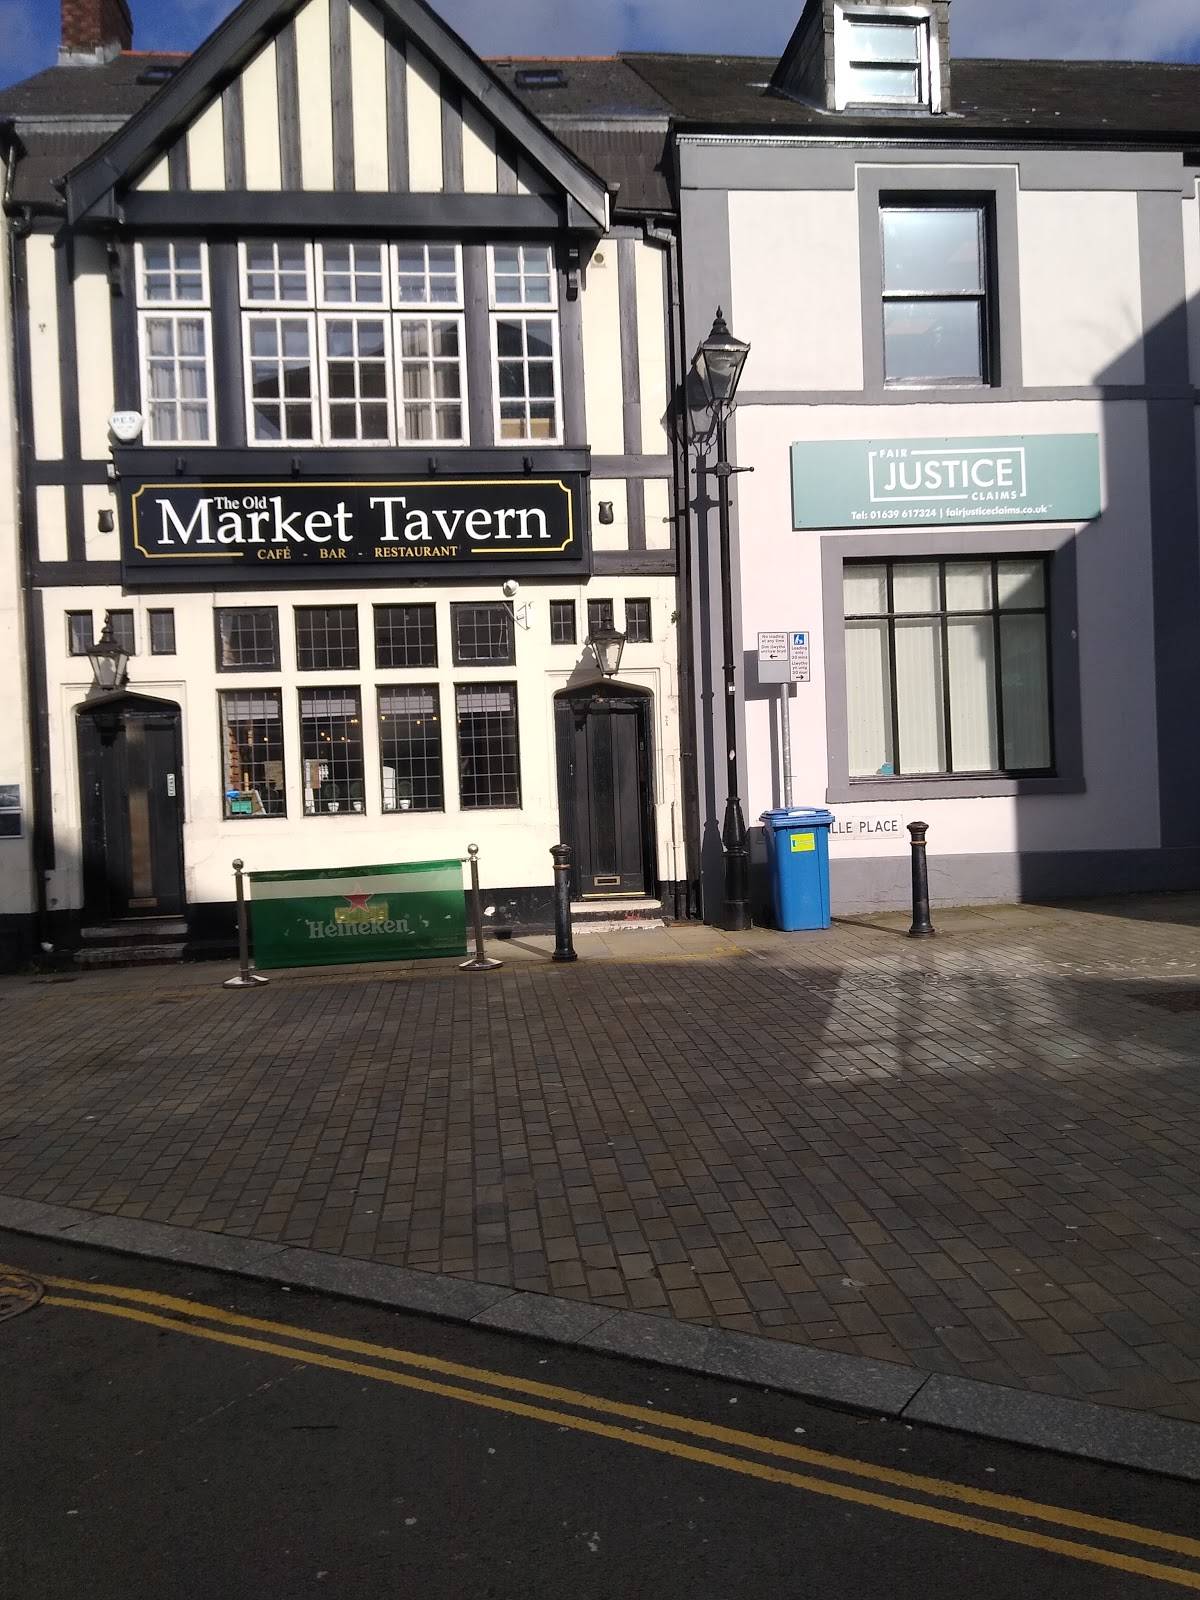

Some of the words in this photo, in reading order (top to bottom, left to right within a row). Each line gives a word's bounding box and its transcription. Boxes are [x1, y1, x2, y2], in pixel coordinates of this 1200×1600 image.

[879, 449, 909, 458] FAIR
[883, 458, 1014, 490] JUSTICE
[214, 496, 240, 510] The
[242, 495, 267, 510] Old
[971, 490, 1018, 501] CLAIMS
[851, 510, 868, 520] Tel:
[869, 509, 900, 520] 01639
[901, 508, 937, 518] 617324
[945, 504, 1048, 518] fairjusticeclaims.co.uk
[155, 496, 354, 545] Market
[369, 496, 551, 541] Tavern
[257, 546, 292, 560] CAFÉ
[319, 548, 347, 559] BAR
[374, 545, 459, 558] RESTAURANT
[859, 820, 899, 833] PLACE
[305, 918, 411, 939] Heineken
